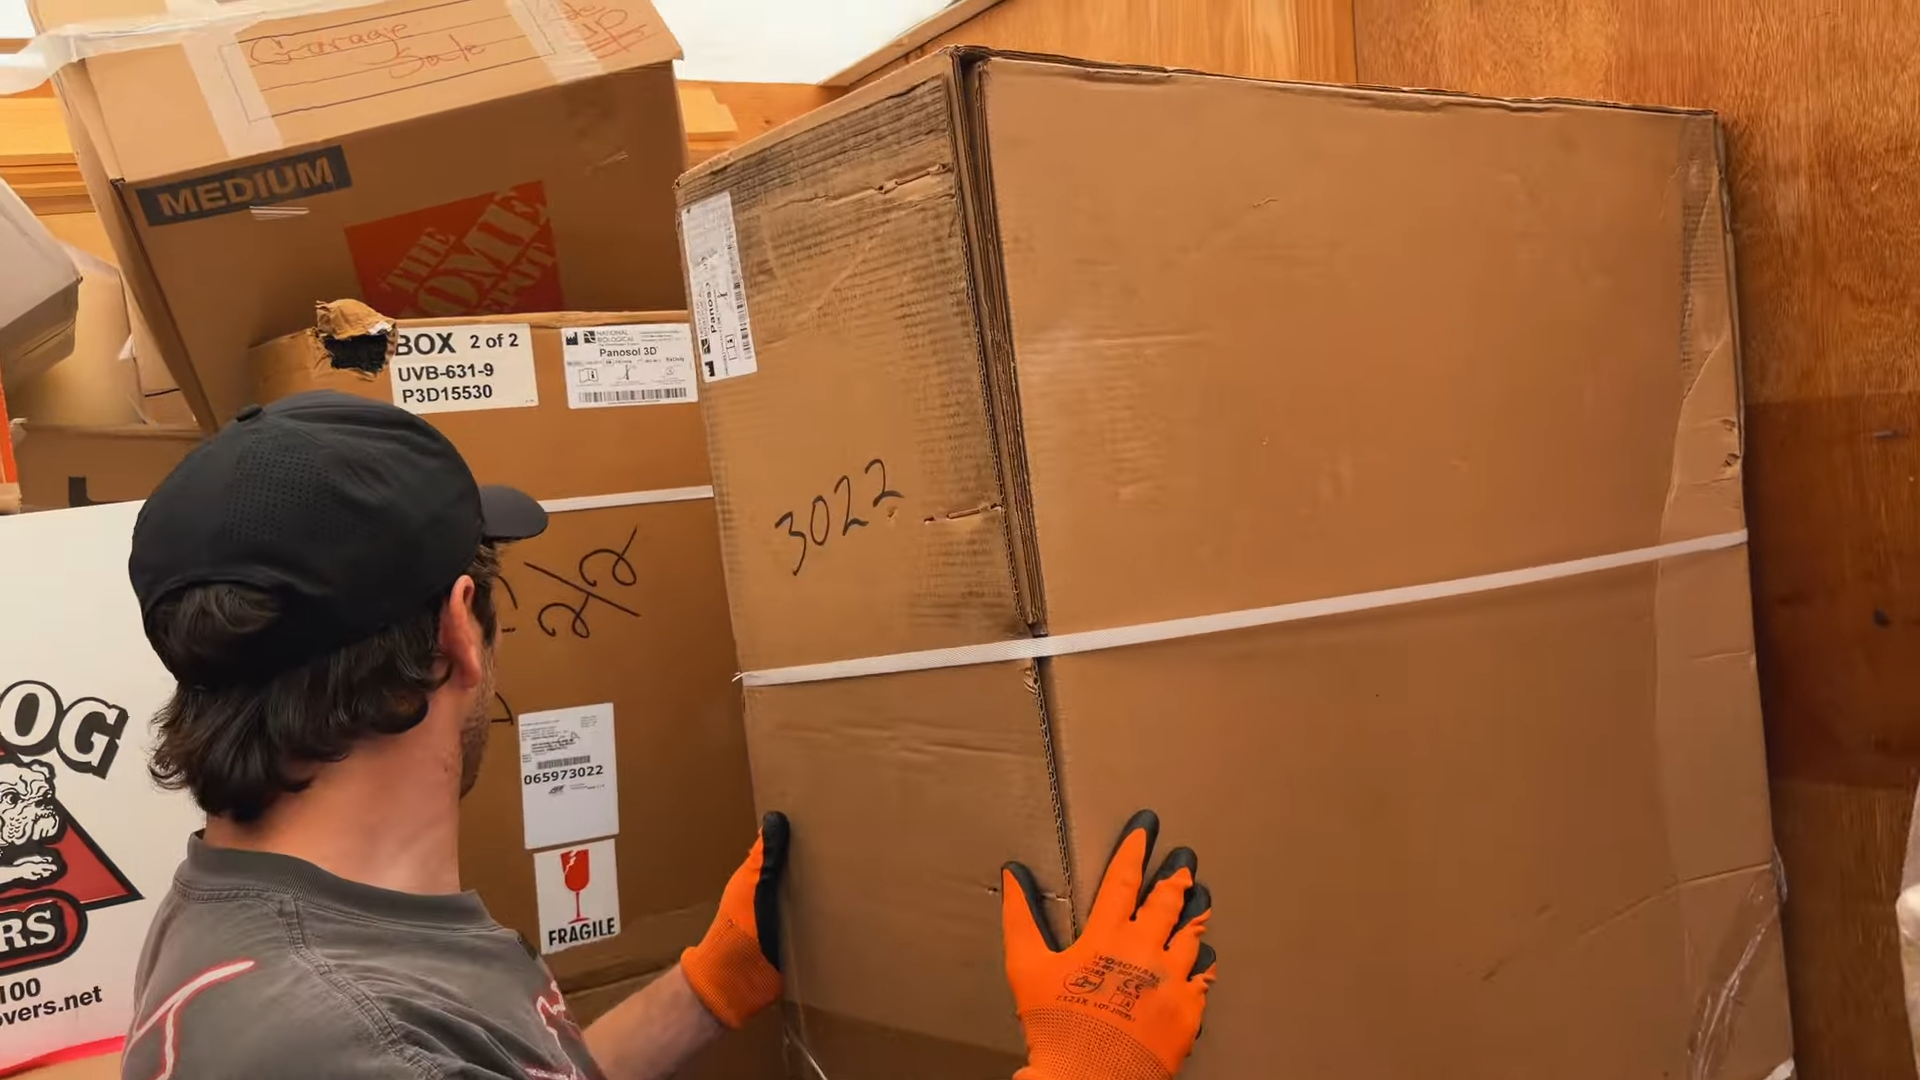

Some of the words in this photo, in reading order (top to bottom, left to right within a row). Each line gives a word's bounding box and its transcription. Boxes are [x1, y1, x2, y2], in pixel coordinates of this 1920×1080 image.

[249, 22, 409, 68] Garage
[389, 34, 487, 79] Sale
[157, 156, 335, 217] MEDIUM
[378, 226, 457, 294] THE
[399, 192, 549, 317] OME
[476, 242, 556, 314] EPOT
[395, 332, 457, 356] BOX
[470, 335, 481, 349] 2
[486, 334, 504, 348] of
[508, 333, 519, 347] 2
[600, 348, 641, 357] Panosol
[644, 346, 657, 356] 3D
[398, 363, 494, 382] UVB-631-9
[402, 384, 493, 403] P3D15530
[775, 459, 905, 577] 3022
[524, 765, 604, 785] 065973022
[548, 917, 616, 946] FRAGILE
